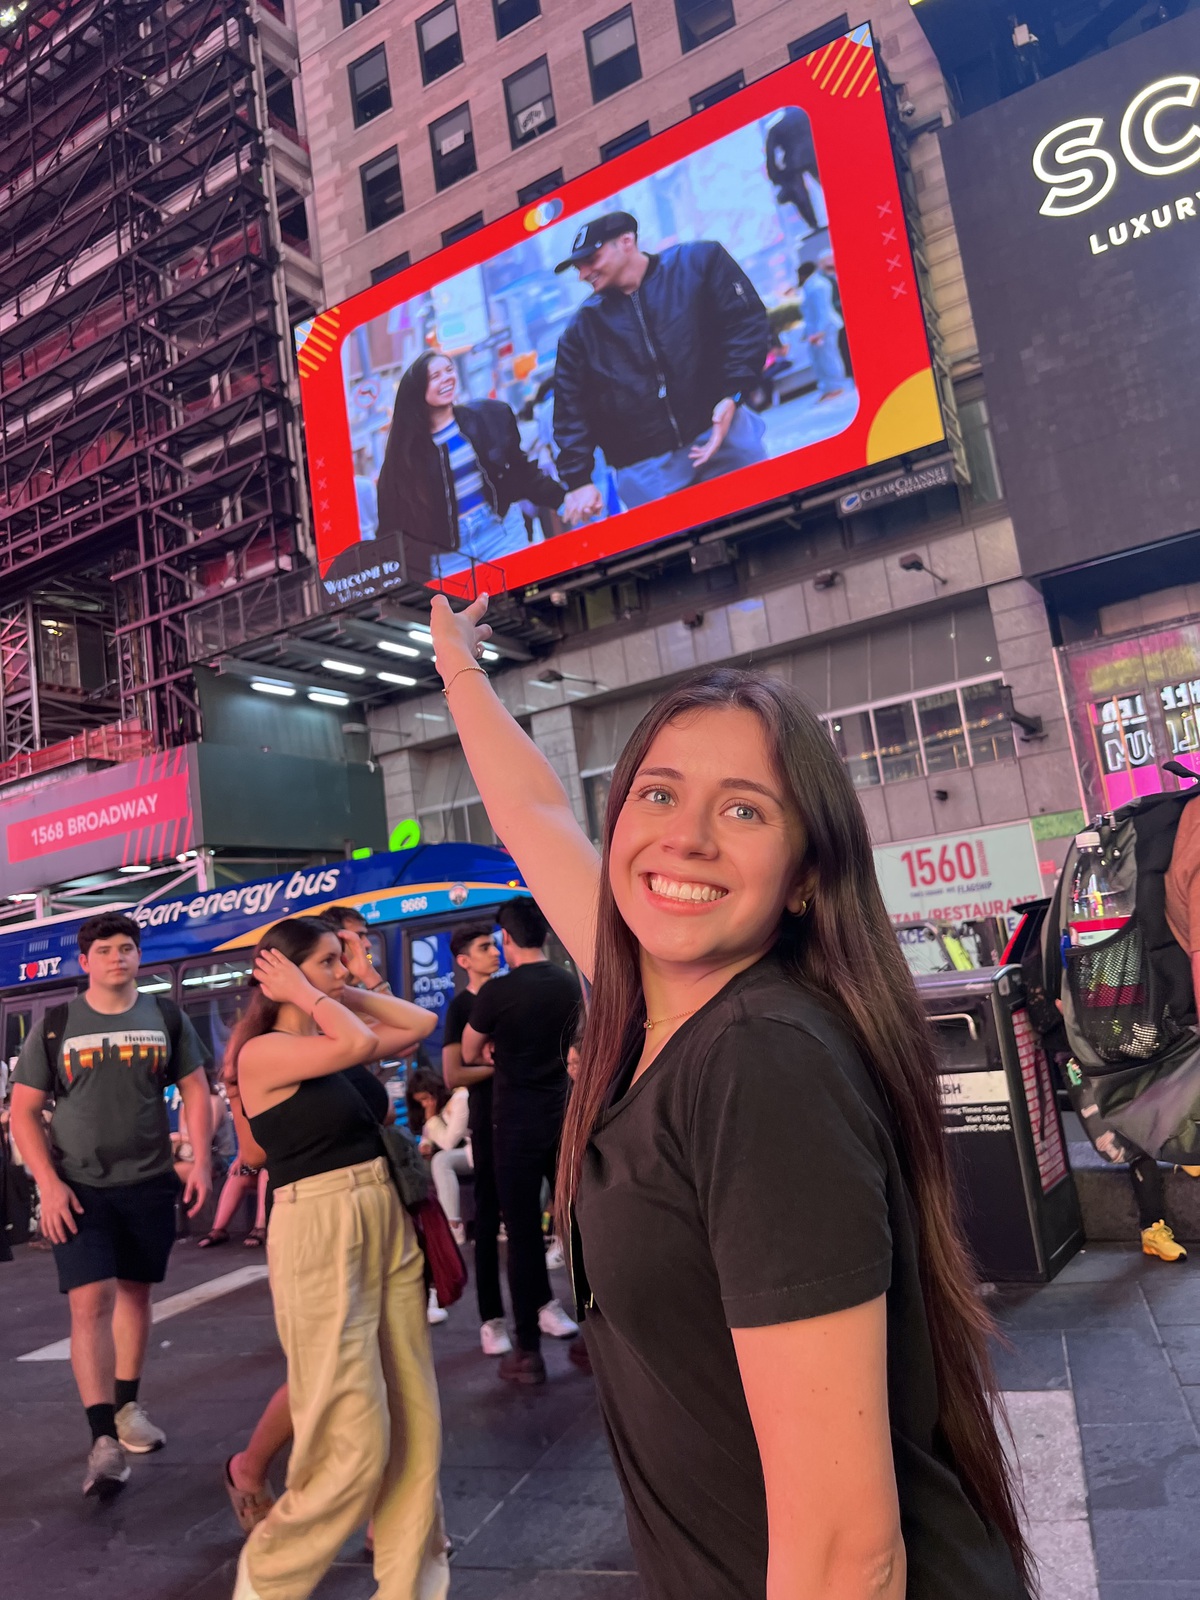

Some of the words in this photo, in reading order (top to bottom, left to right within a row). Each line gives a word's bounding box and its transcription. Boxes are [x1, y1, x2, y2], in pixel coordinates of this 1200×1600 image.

[1090, 191, 1200, 255] LUXUR
[31, 821, 64, 846] 1568
[67, 794, 158, 836] BROADWAY
[284, 868, 340, 899] bus
[901, 841, 976, 888] 1560
